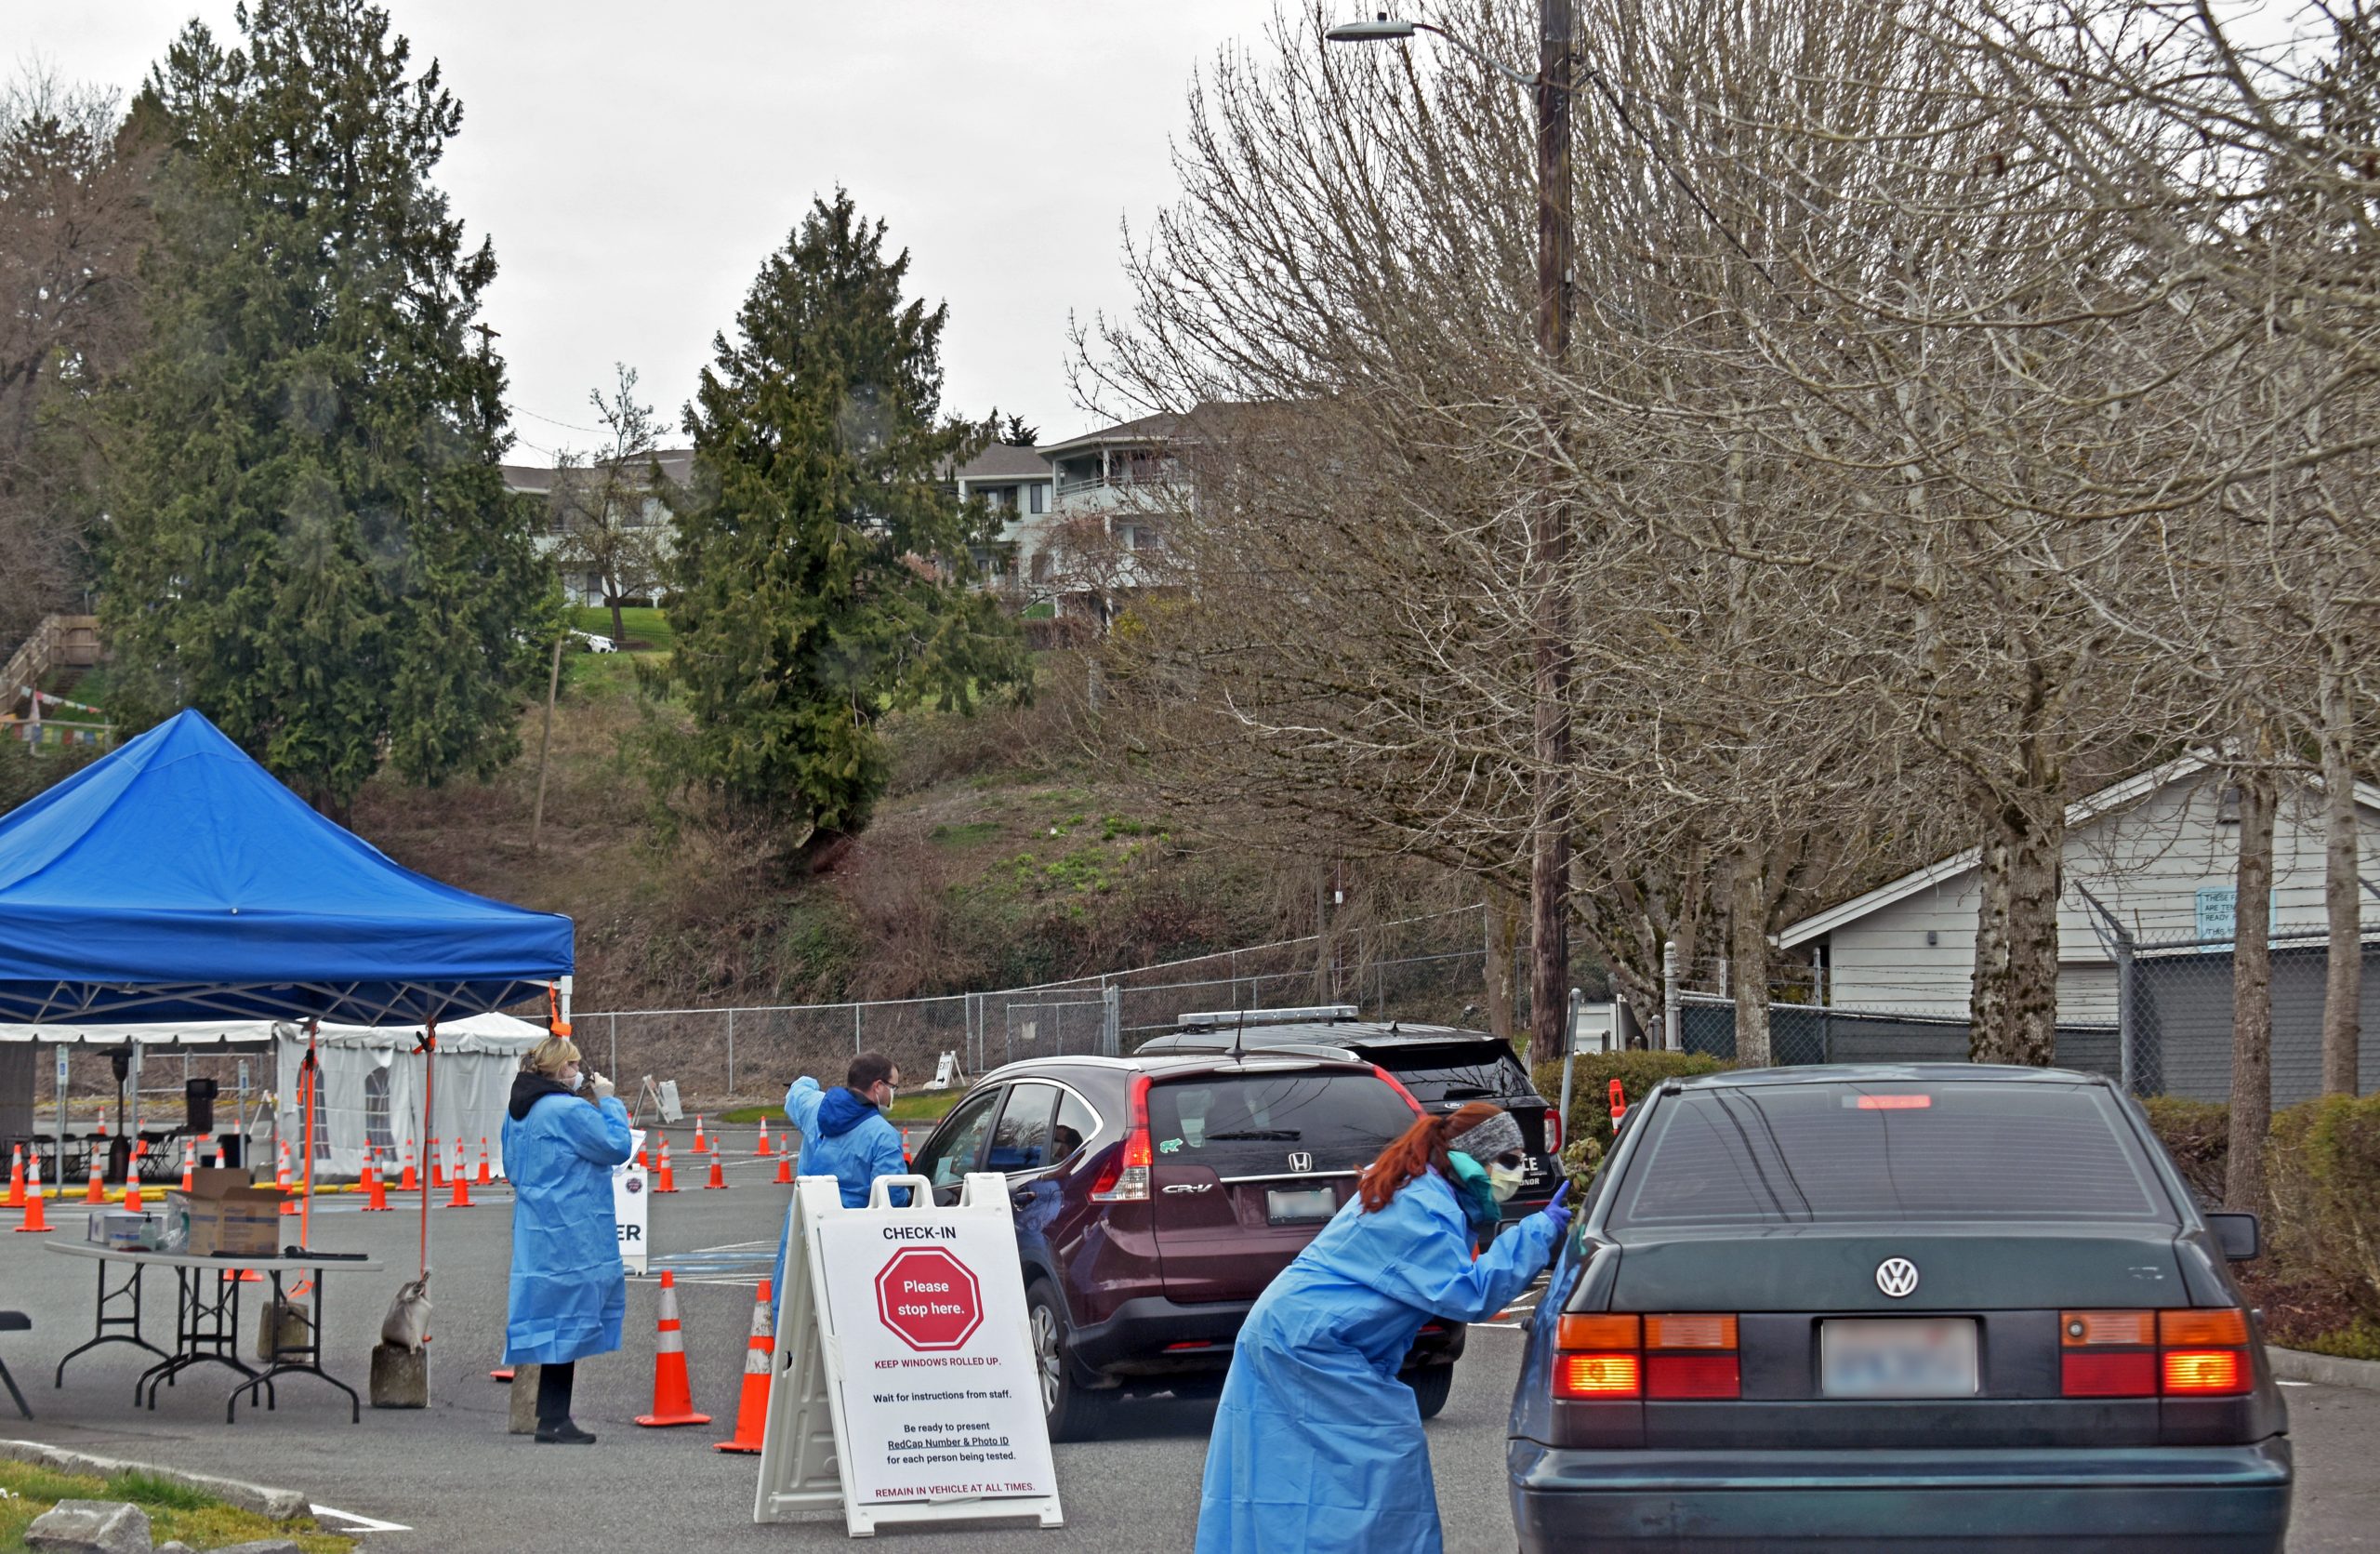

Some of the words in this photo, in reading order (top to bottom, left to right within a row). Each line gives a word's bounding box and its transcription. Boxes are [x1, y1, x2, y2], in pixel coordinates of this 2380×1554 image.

[1162, 1184, 1213, 1194] CR-V
[882, 1226, 957, 1240] CHECK-IN
[903, 1280, 949, 1293] Please
[898, 1304, 928, 1317] stop
[931, 1302, 965, 1315] here.
[874, 1360, 899, 1369] KEEP
[901, 1358, 947, 1368] WINDOWS
[949, 1357, 985, 1366] ROLLED
[986, 1357, 1001, 1366] UP.
[873, 1394, 894, 1402] Wait
[896, 1393, 909, 1401] for
[911, 1391, 964, 1401] instructions
[966, 1389, 987, 1399] from
[989, 1389, 1012, 1399] staff.
[904, 1424, 916, 1432] Be
[918, 1423, 943, 1433] ready
[945, 1423, 954, 1431] to
[957, 1422, 990, 1432] present
[888, 1440, 922, 1450] RedCap
[925, 1438, 960, 1447] Number
[963, 1438, 970, 1446] &
[972, 1437, 998, 1446] Photo
[999, 1436, 1009, 1445] ID
[887, 1455, 900, 1464] for
[902, 1454, 924, 1463] each
[927, 1454, 958, 1464] person
[959, 1452, 985, 1462] being
[986, 1451, 1016, 1461] tested.
[875, 1488, 914, 1497] REMAIN
[916, 1487, 927, 1495] IN
[928, 1484, 968, 1494] VEHICLE
[971, 1484, 983, 1493] AT
[985, 1483, 1002, 1492] ALL
[1004, 1482, 1036, 1492] TIMES.
